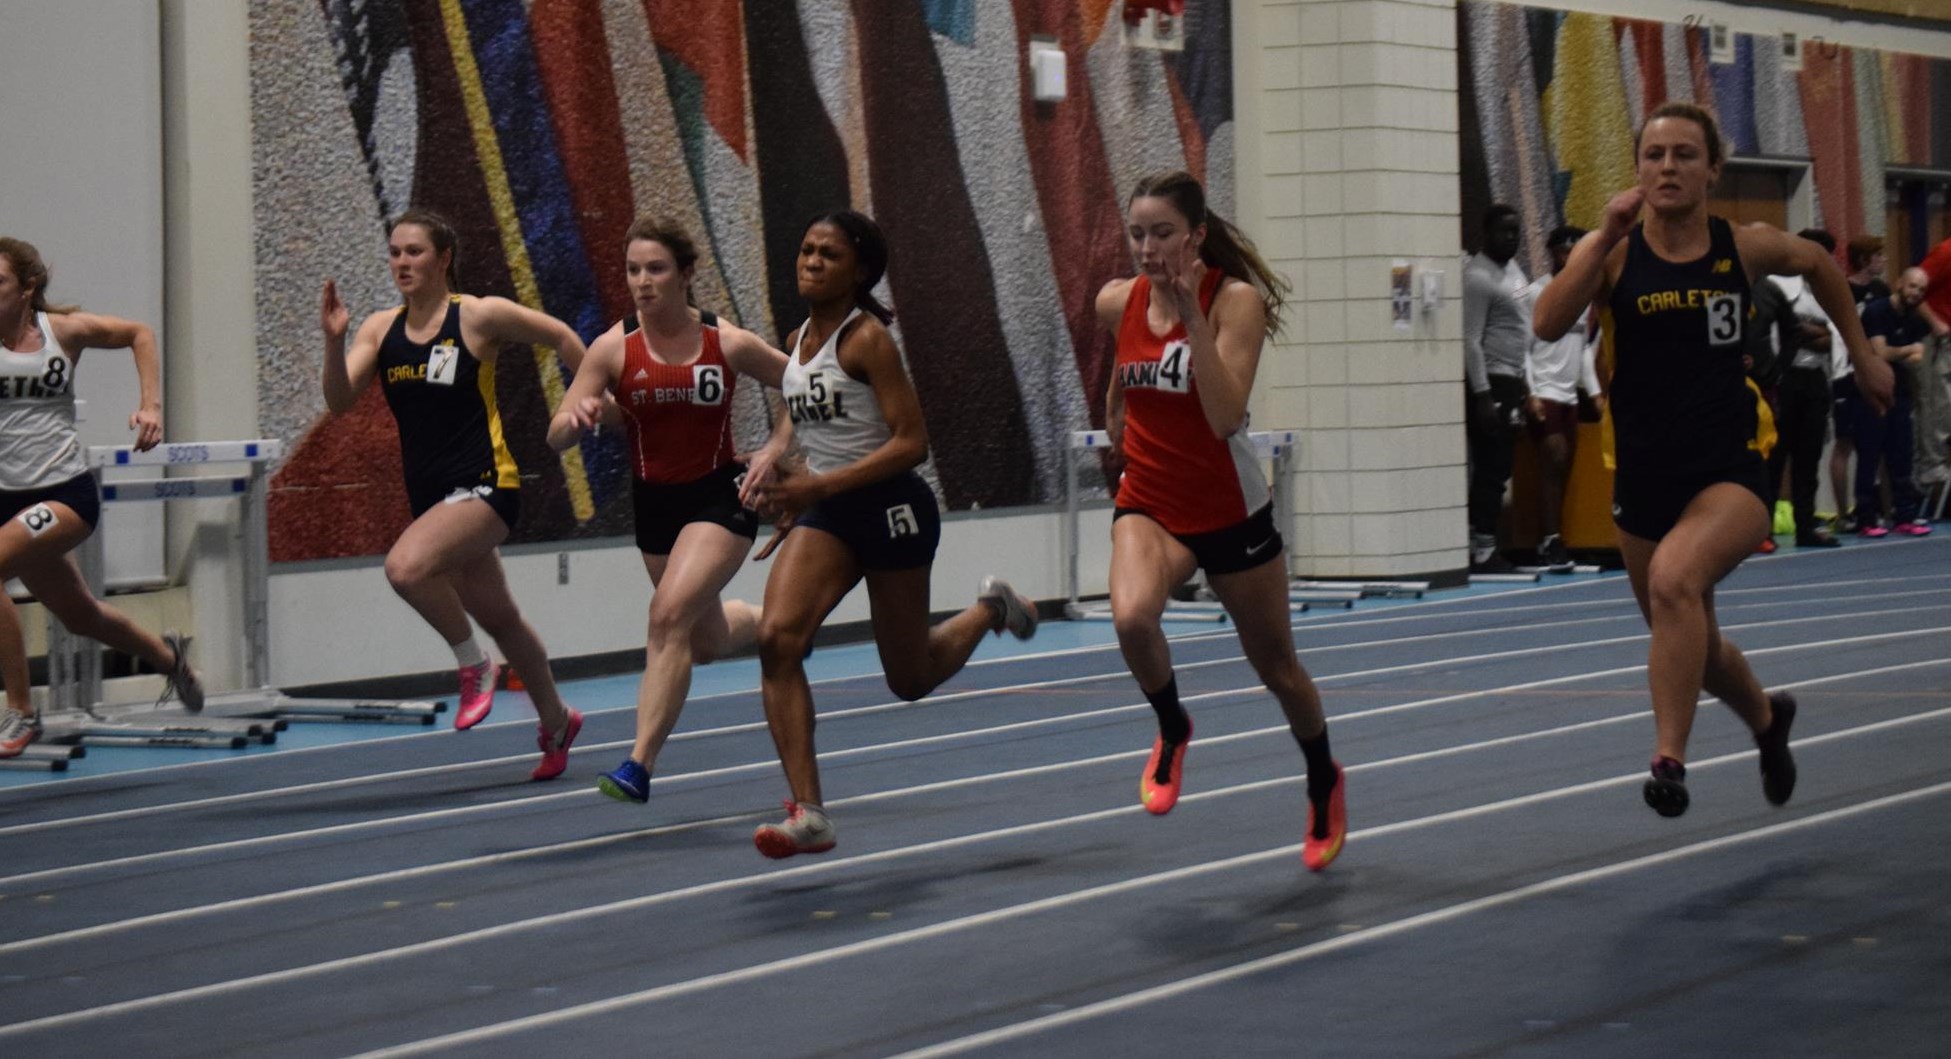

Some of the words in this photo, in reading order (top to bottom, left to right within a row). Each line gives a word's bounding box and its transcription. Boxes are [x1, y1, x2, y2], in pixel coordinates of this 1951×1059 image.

[1637, 289, 1728, 314] CARLET
[1713, 298, 1736, 341] 3
[43, 356, 65, 388] 8
[434, 349, 454, 379] 7
[1161, 346, 1183, 388] 4
[699, 367, 720, 402] 6
[809, 372, 826, 403] 5
[26, 508, 52, 531] 8
[890, 508, 912, 535] 5
